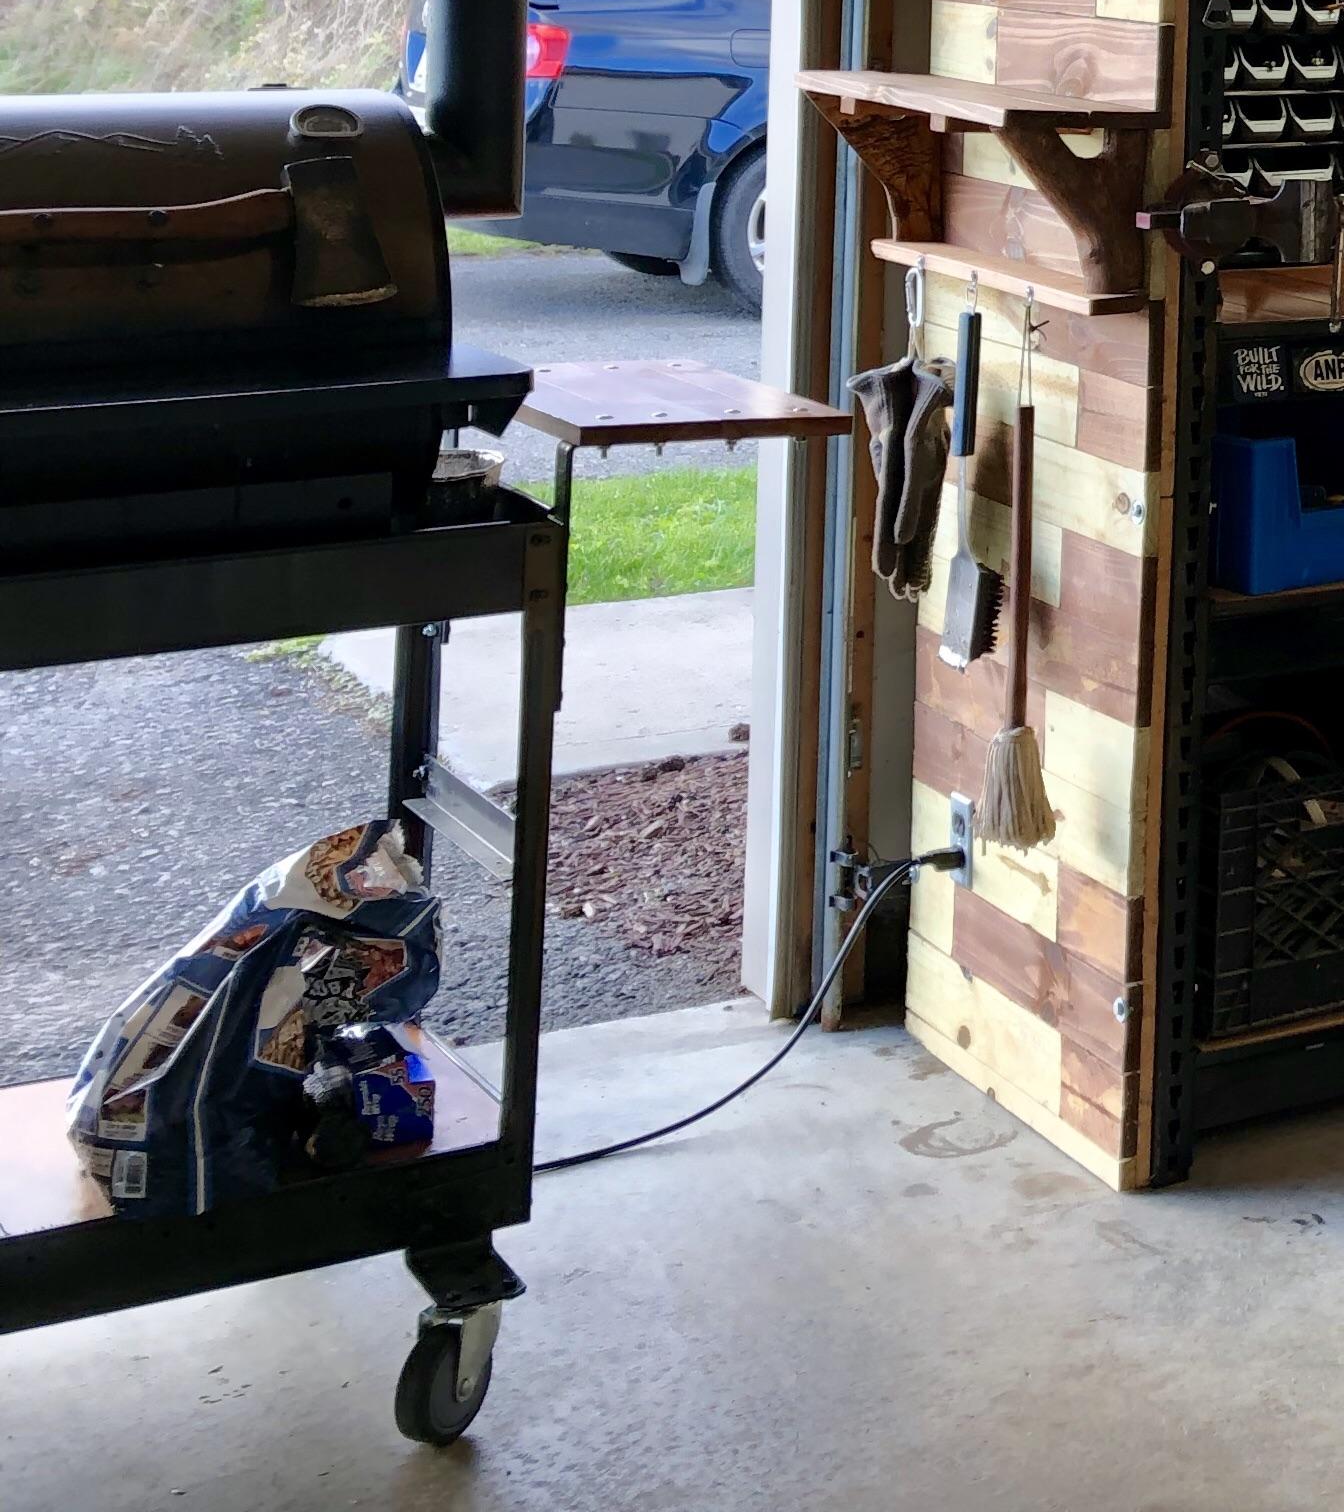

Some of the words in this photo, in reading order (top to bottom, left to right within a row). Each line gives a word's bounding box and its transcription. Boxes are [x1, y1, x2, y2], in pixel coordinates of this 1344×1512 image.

[1233, 345, 1281, 367] BUILT
[1239, 364, 1261, 375] FOR
[1261, 364, 1281, 375] THE
[1236, 373, 1285, 393] WILD.
